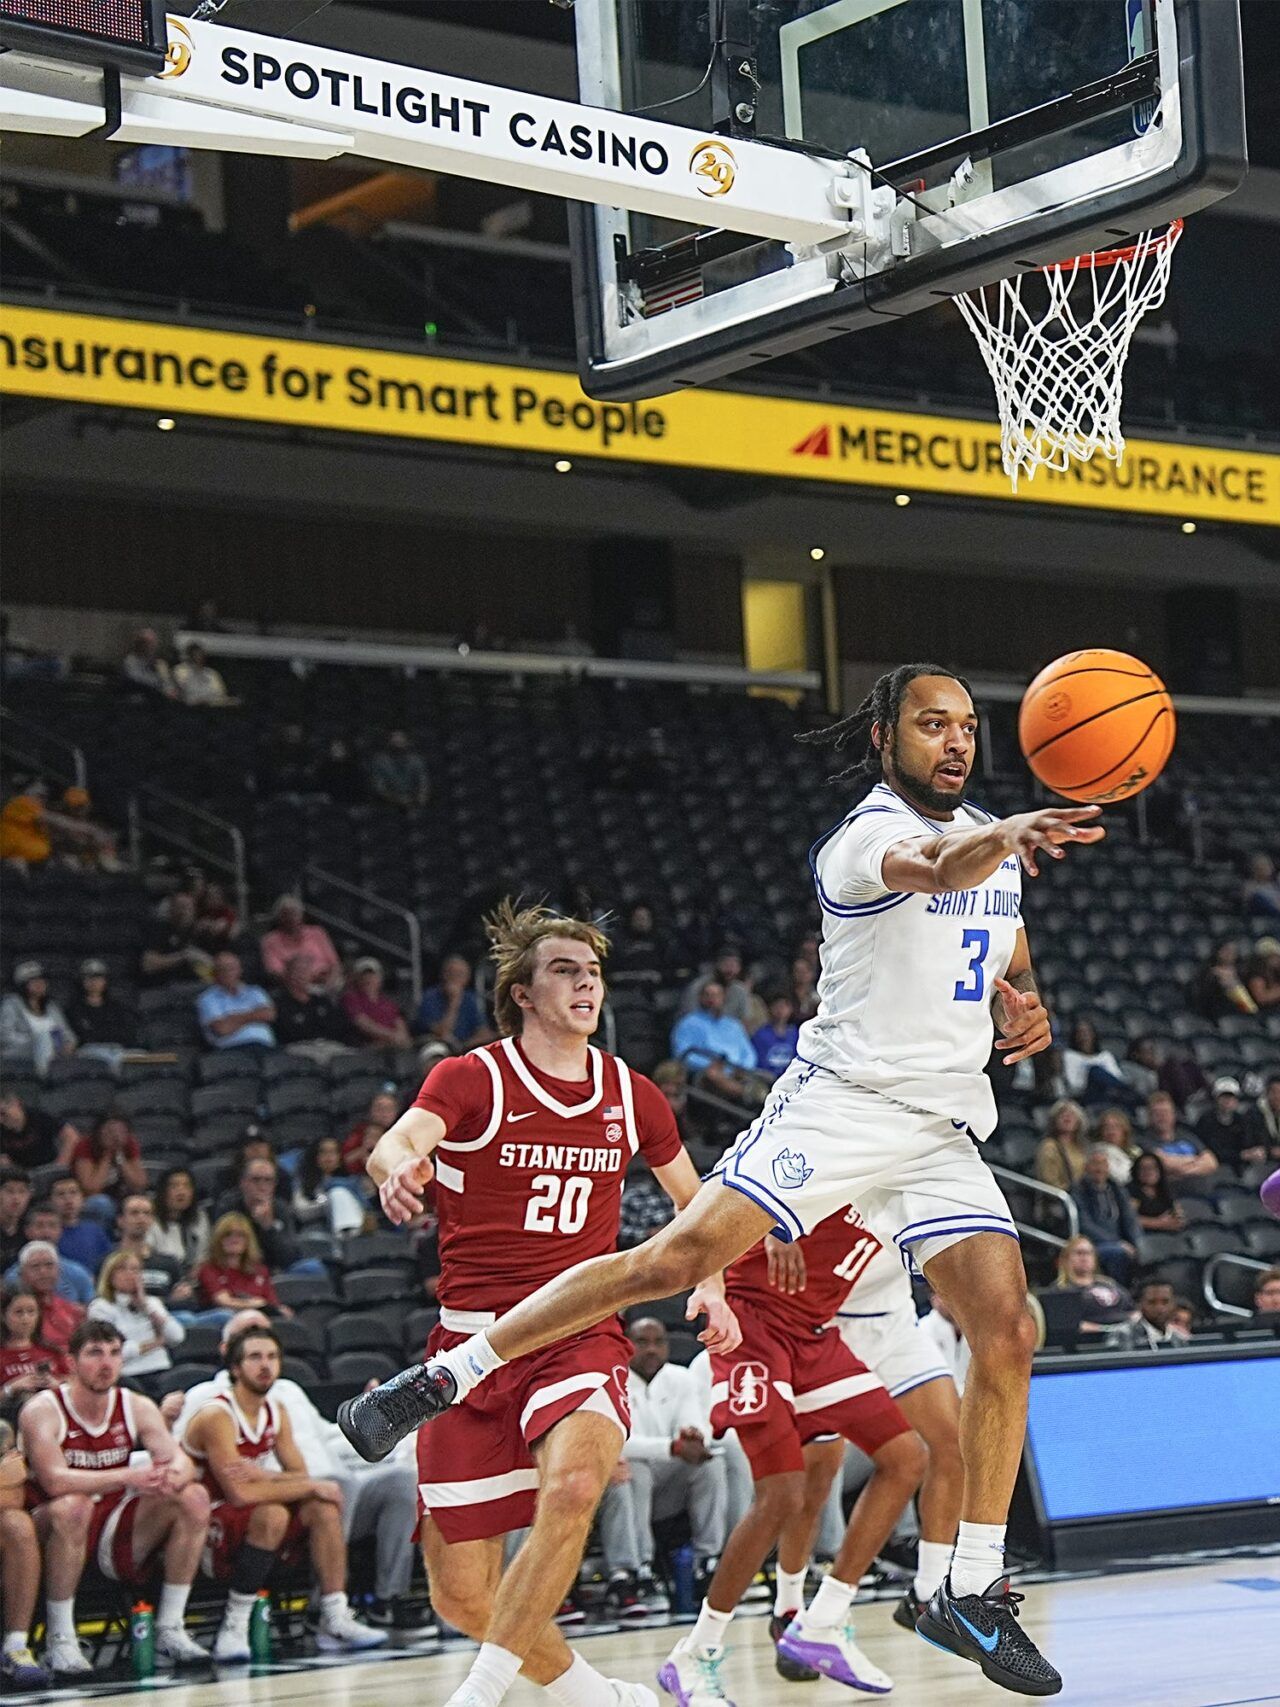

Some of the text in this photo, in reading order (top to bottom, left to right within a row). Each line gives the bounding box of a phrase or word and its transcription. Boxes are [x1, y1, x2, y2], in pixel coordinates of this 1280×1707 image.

[220, 46, 490, 138] SPOTLIGHT
[509, 112, 669, 176] CASINO
[261, 353, 333, 402] for
[346, 366, 500, 421] Smart
[512, 385, 666, 446] People
[838, 424, 1032, 480] MERCUR
[926, 889, 1020, 918] SAINT LOUIS
[953, 928, 990, 1002] 3
[499, 1143, 622, 1173] STANFORD
[523, 1174, 594, 1235] 20
[832, 1237, 879, 1282] 11
